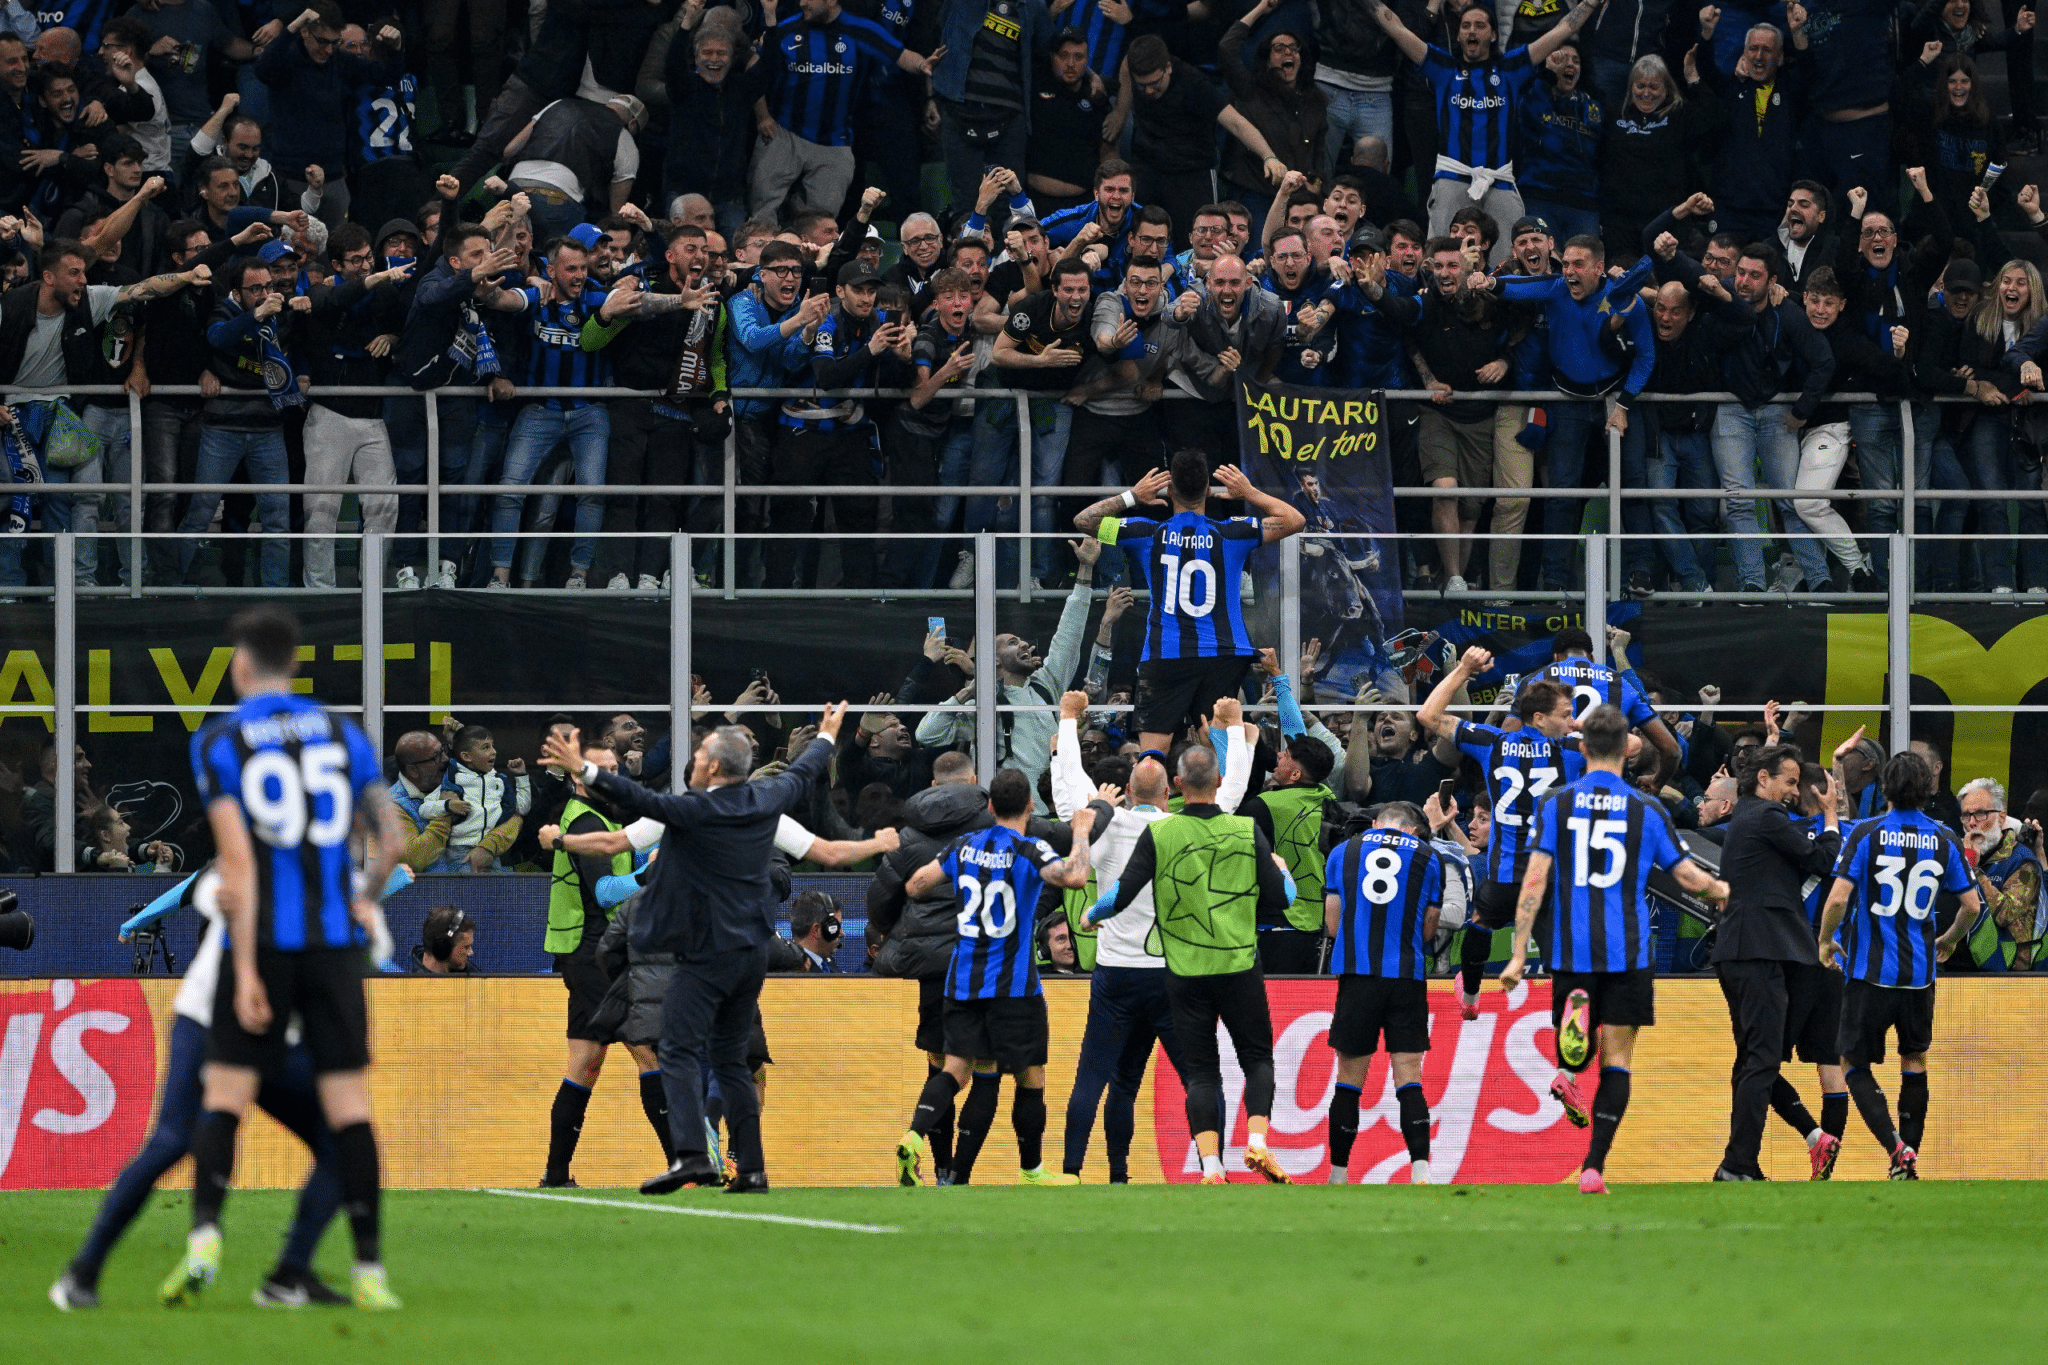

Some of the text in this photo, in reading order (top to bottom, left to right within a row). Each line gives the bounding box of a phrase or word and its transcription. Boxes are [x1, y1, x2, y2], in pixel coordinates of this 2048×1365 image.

[1243, 382, 1379, 425] LAUTARO
[1248, 412, 1377, 461] 10 el toro
[1161, 530, 1213, 549] LAUTARO
[1160, 554, 1216, 617] 10
[1460, 609, 1526, 632] INTER
[1550, 665, 1614, 682] DUMFRIES
[1501, 741, 1552, 758] BARELLA
[242, 742, 352, 848] 95
[1493, 766, 1559, 826] 23
[1574, 792, 1627, 811] ACERBI
[1362, 834, 1419, 849] GOSENS
[1566, 817, 1628, 888] 15
[1879, 830, 1939, 850] DARMIAN
[1362, 848, 1402, 904] 8
[1870, 855, 1944, 920] 36
[957, 874, 1017, 938] 20
